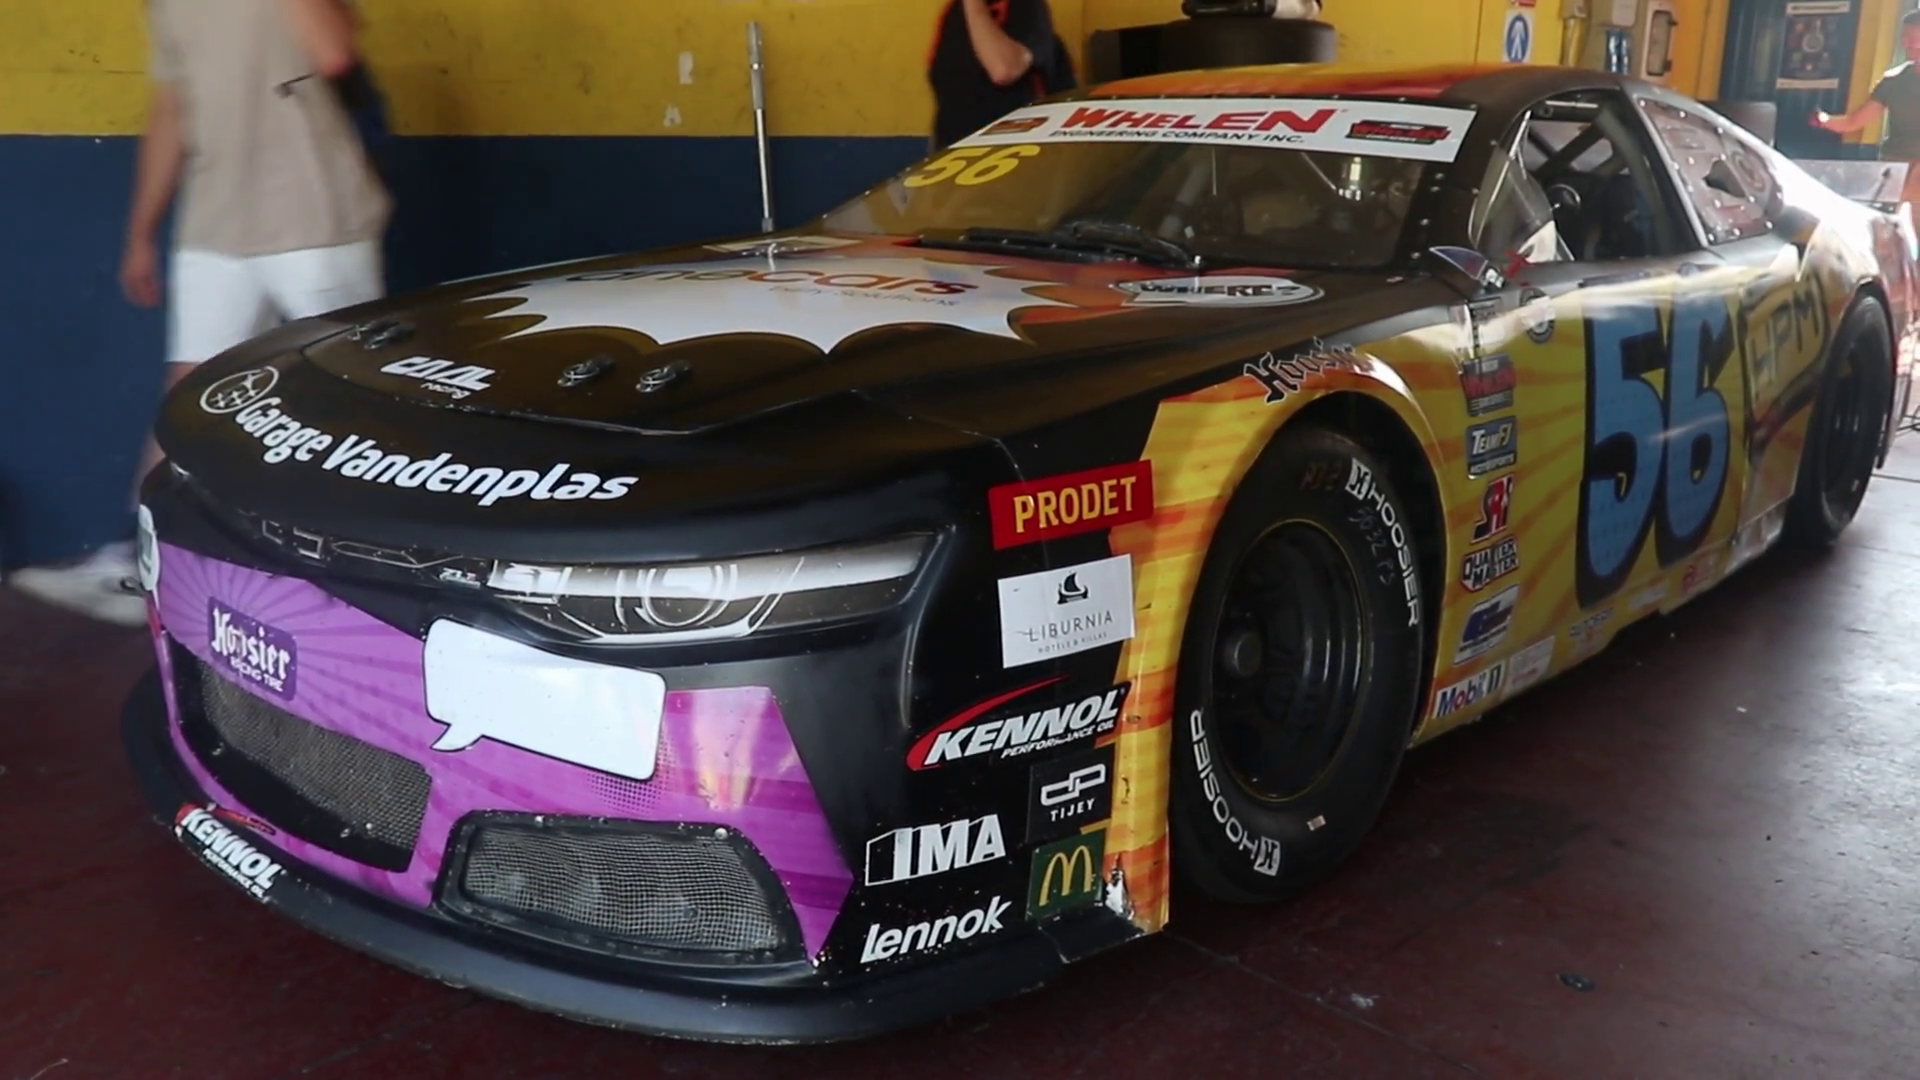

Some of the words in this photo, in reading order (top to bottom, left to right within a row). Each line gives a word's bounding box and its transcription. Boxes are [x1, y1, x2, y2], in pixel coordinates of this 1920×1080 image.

[1049, 130, 1157, 138] ENGINEERING
[1162, 131, 1257, 141] COMPANY
[1262, 134, 1304, 144] INC.
[1060, 107, 1338, 133] WHELEN
[903, 144, 1041, 187] 56
[235, 397, 333, 464] Garage
[321, 434, 640, 506] Vandenplas
[1577, 292, 1735, 606] 56
[1013, 476, 1137, 533] PRODET
[1367, 482, 1419, 627] HOOSIER
[211, 607, 290, 680] Hoosier
[1029, 610, 1113, 643] LIBURNIA
[924, 689, 1119, 766] KENNOL
[1097, 718, 1115, 733] OIL
[1050, 798, 1095, 822] TIJEY
[1190, 707, 1259, 860] HOOSIER
[180, 807, 282, 890] KENNOL
[888, 813, 1006, 884] IMA
[860, 895, 1012, 965] lennok
